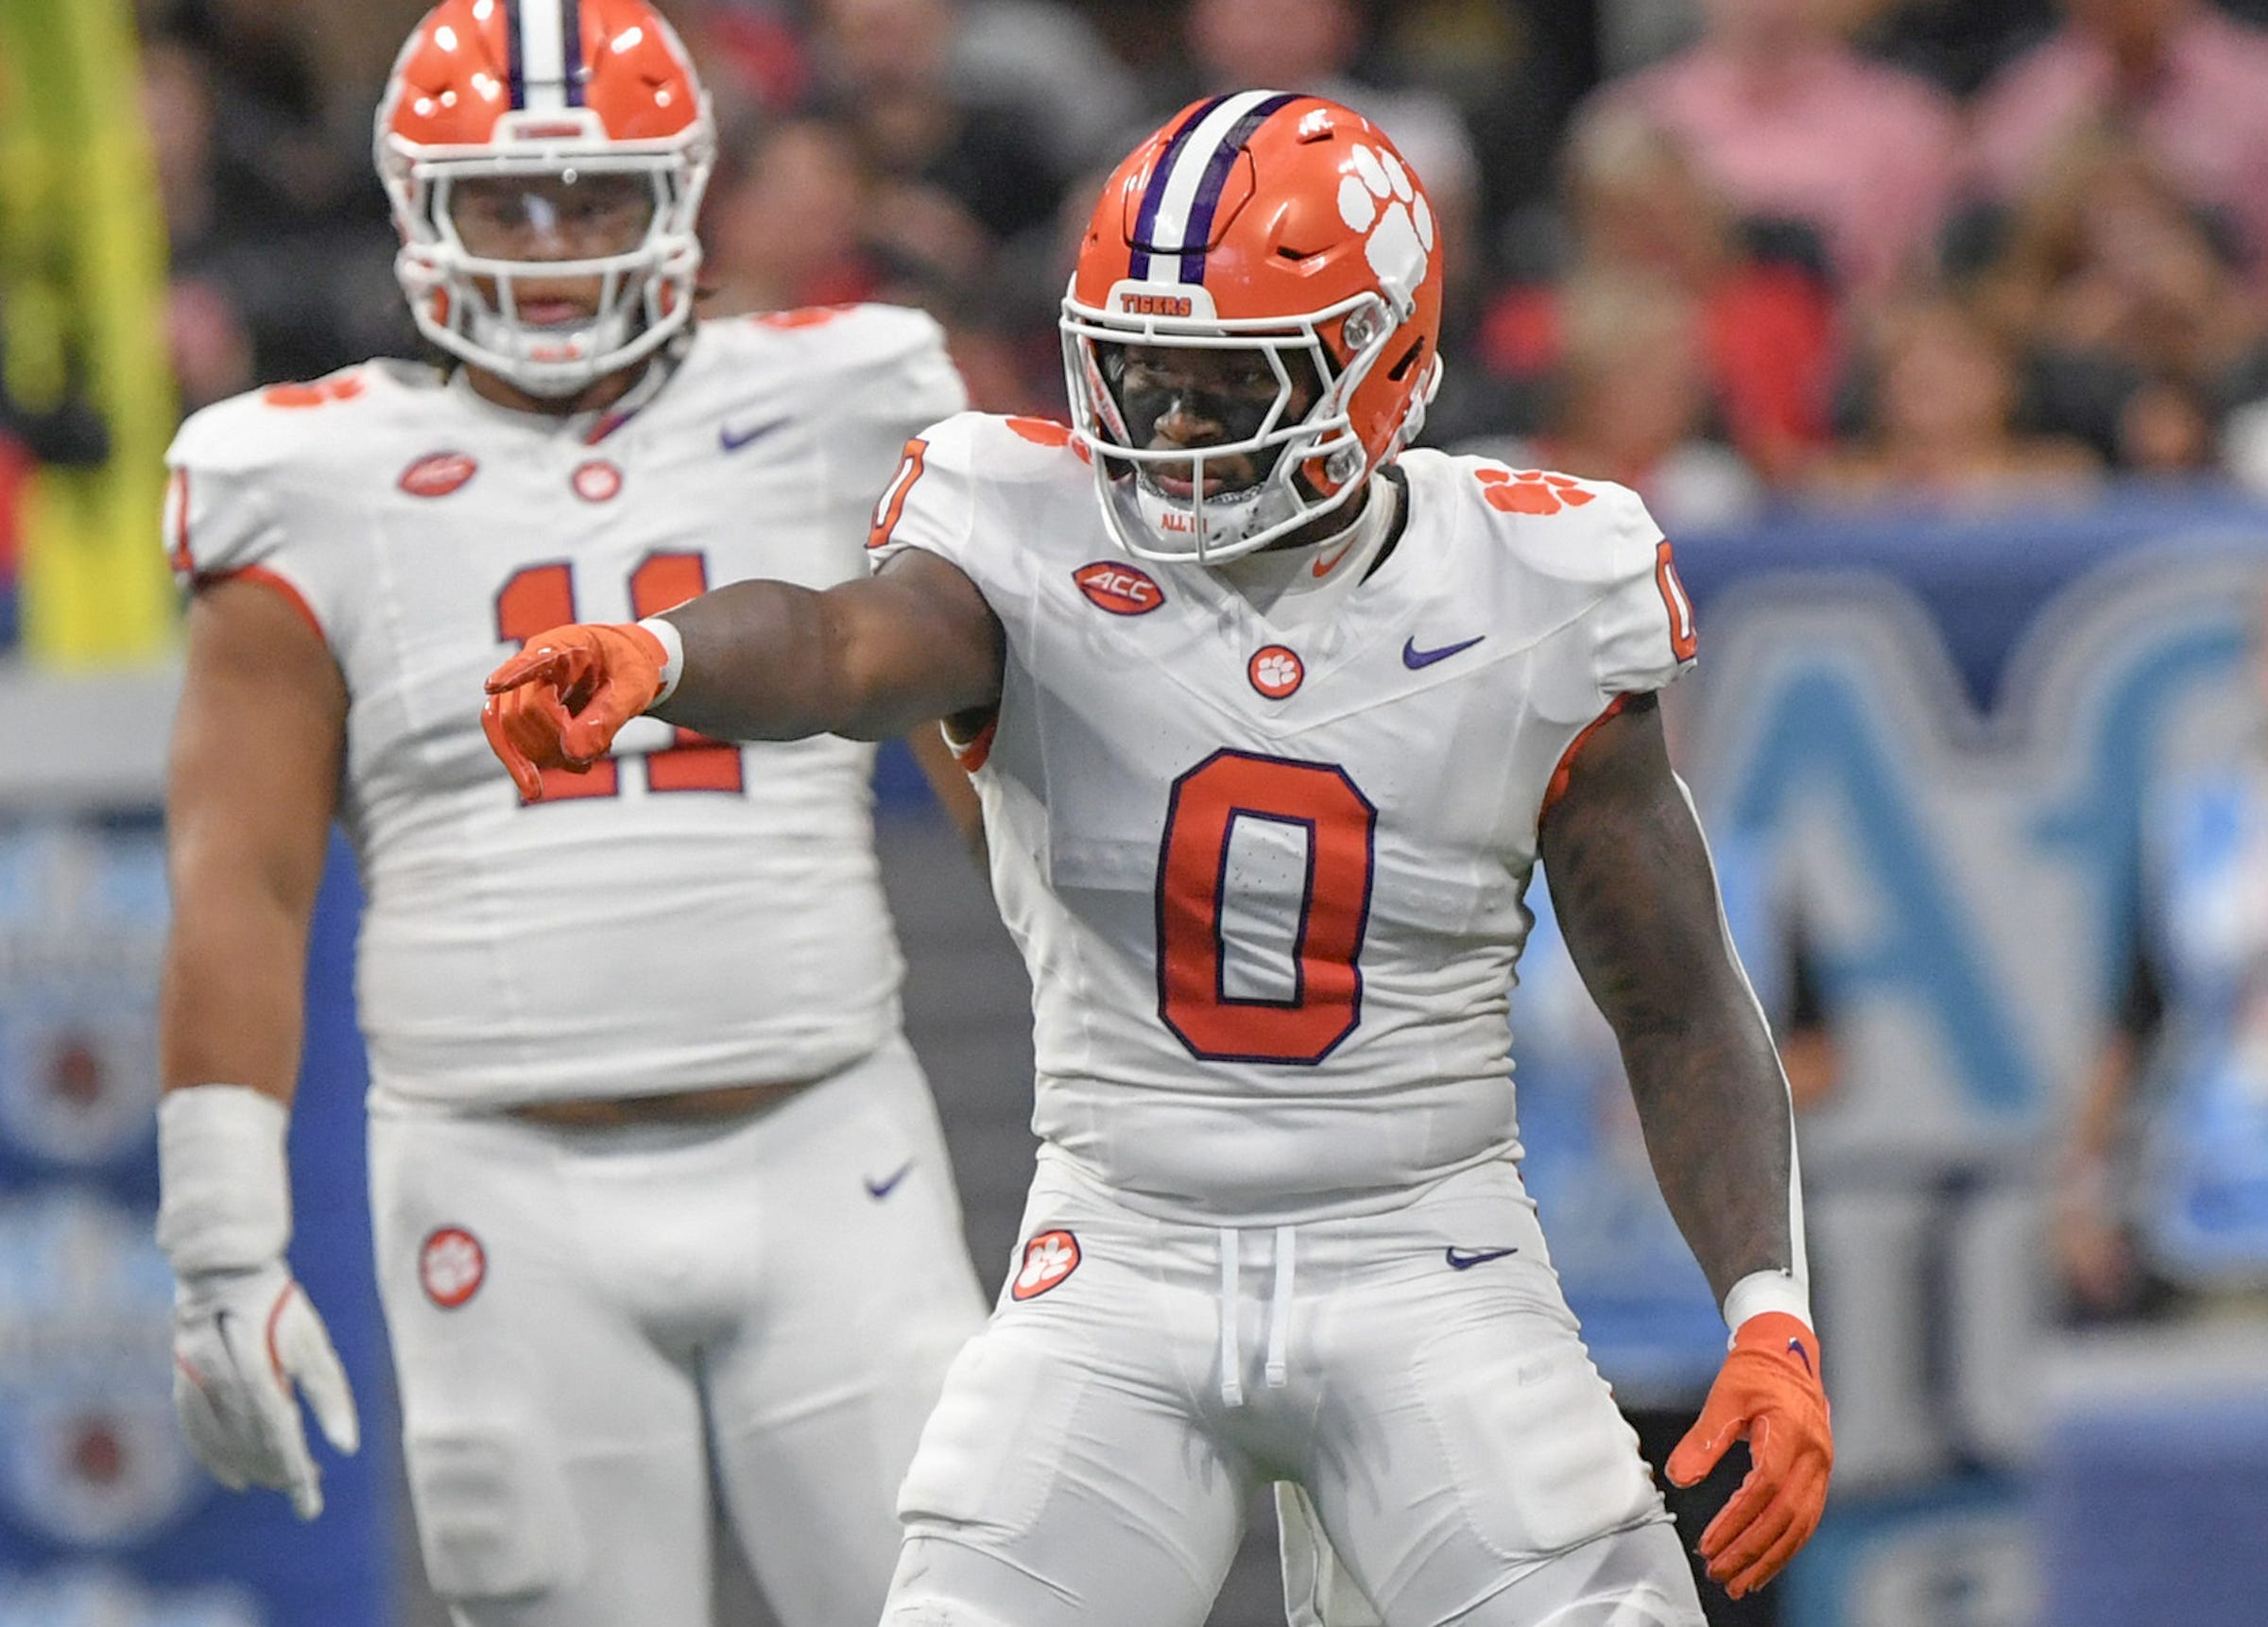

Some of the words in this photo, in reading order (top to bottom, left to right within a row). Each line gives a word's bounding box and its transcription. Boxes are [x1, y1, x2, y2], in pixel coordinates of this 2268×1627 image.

[1120, 292, 1193, 317] TIGERS
[1160, 513, 1187, 532] ALL
[1083, 571, 1154, 602] ACC
[1155, 746, 1378, 1066] 0
